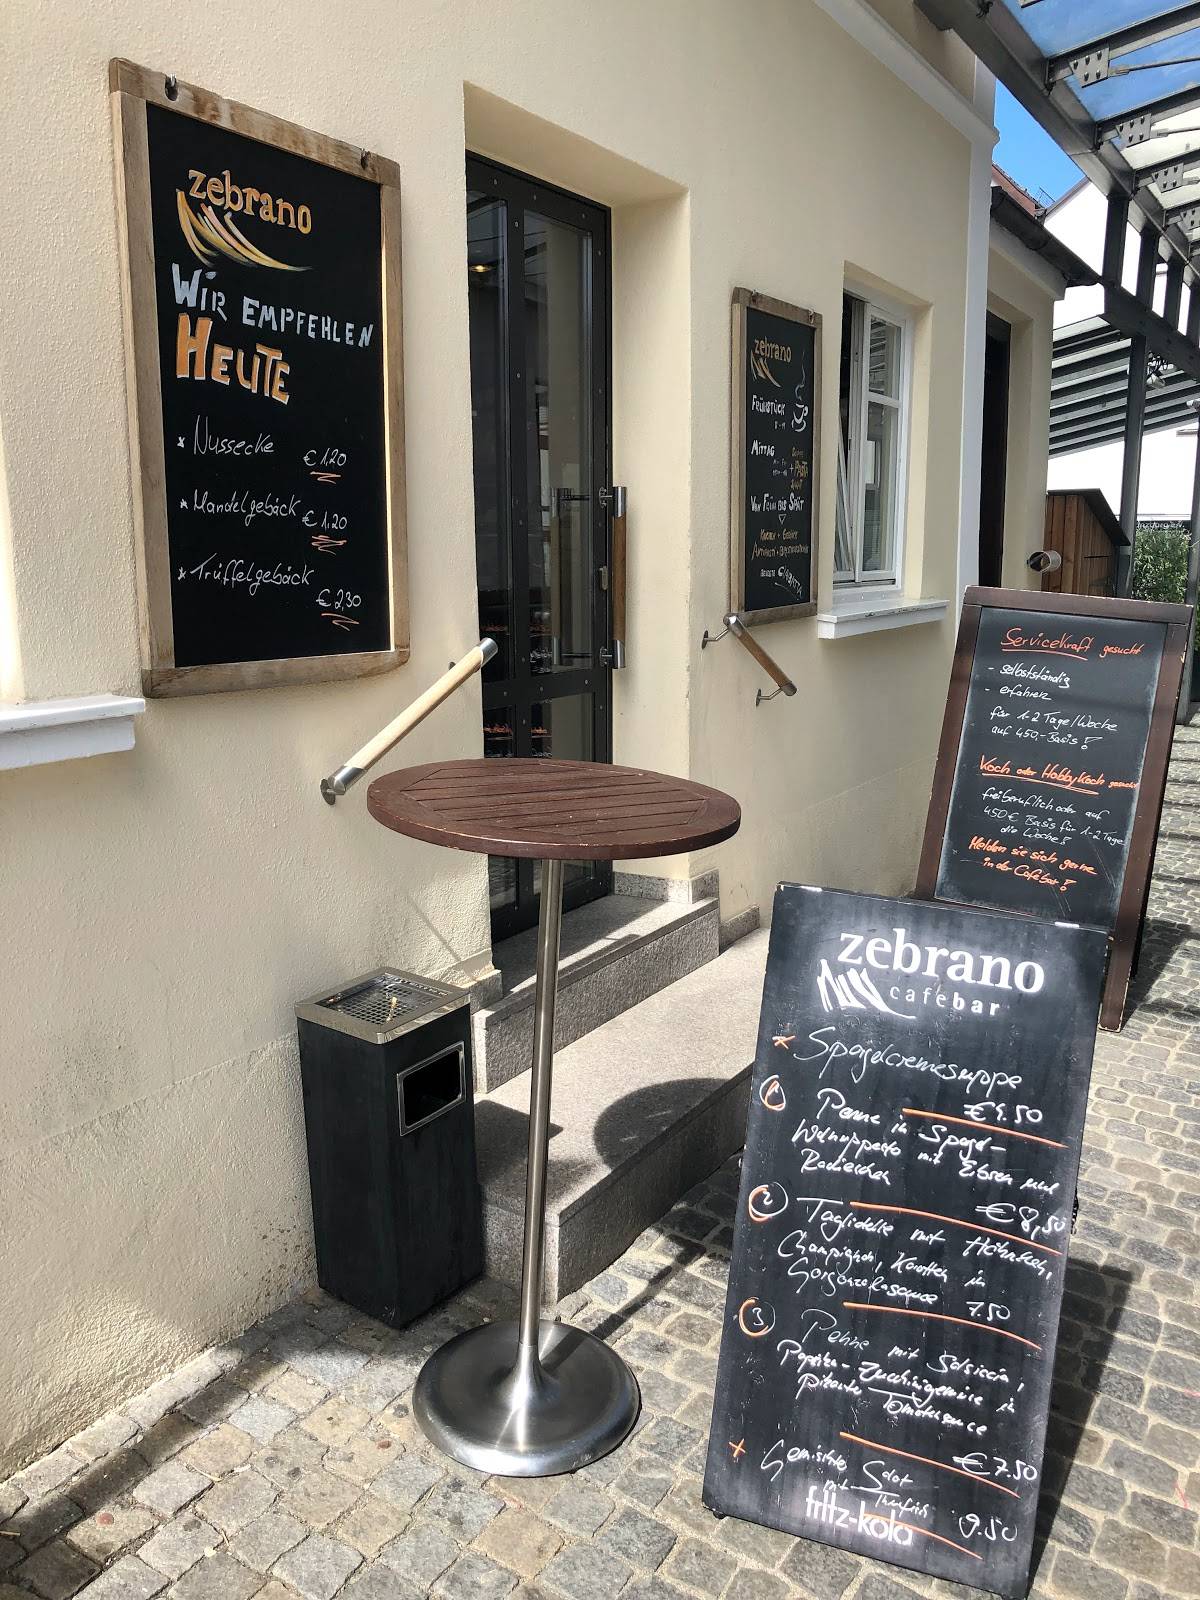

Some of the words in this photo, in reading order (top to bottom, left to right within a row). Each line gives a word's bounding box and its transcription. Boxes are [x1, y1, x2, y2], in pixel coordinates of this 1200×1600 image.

[188, 169, 313, 235] zebrano
[242, 296, 374, 348] EMPFEHLEN
[175, 312, 291, 405] HEUTE
[754, 336, 792, 363] zebrano
[193, 415, 275, 456] Nussecke
[193, 488, 301, 527] Mandelgebäck
[190, 552, 315, 597] Trüffelgebäck
[1099, 642, 1145, 658] gesucht
[999, 662, 1071, 689] selbstständig
[990, 705, 1010, 721] für
[991, 724, 1010, 737] auf
[979, 754, 1011, 775] Koch
[1016, 766, 1037, 777] oder
[1024, 814, 1056, 831] Basis
[1059, 820, 1077, 833] für
[1055, 803, 1076, 815] oder
[1085, 809, 1110, 821] auf
[1000, 826, 1018, 834] die
[968, 835, 1007, 854] Melden
[1010, 845, 1028, 857] sie
[1029, 850, 1058, 864] sich
[1059, 859, 1098, 875] gerne
[982, 857, 994, 867] in
[836, 927, 1045, 993] zebrano
[965, 1300, 1012, 1323] 7.50
